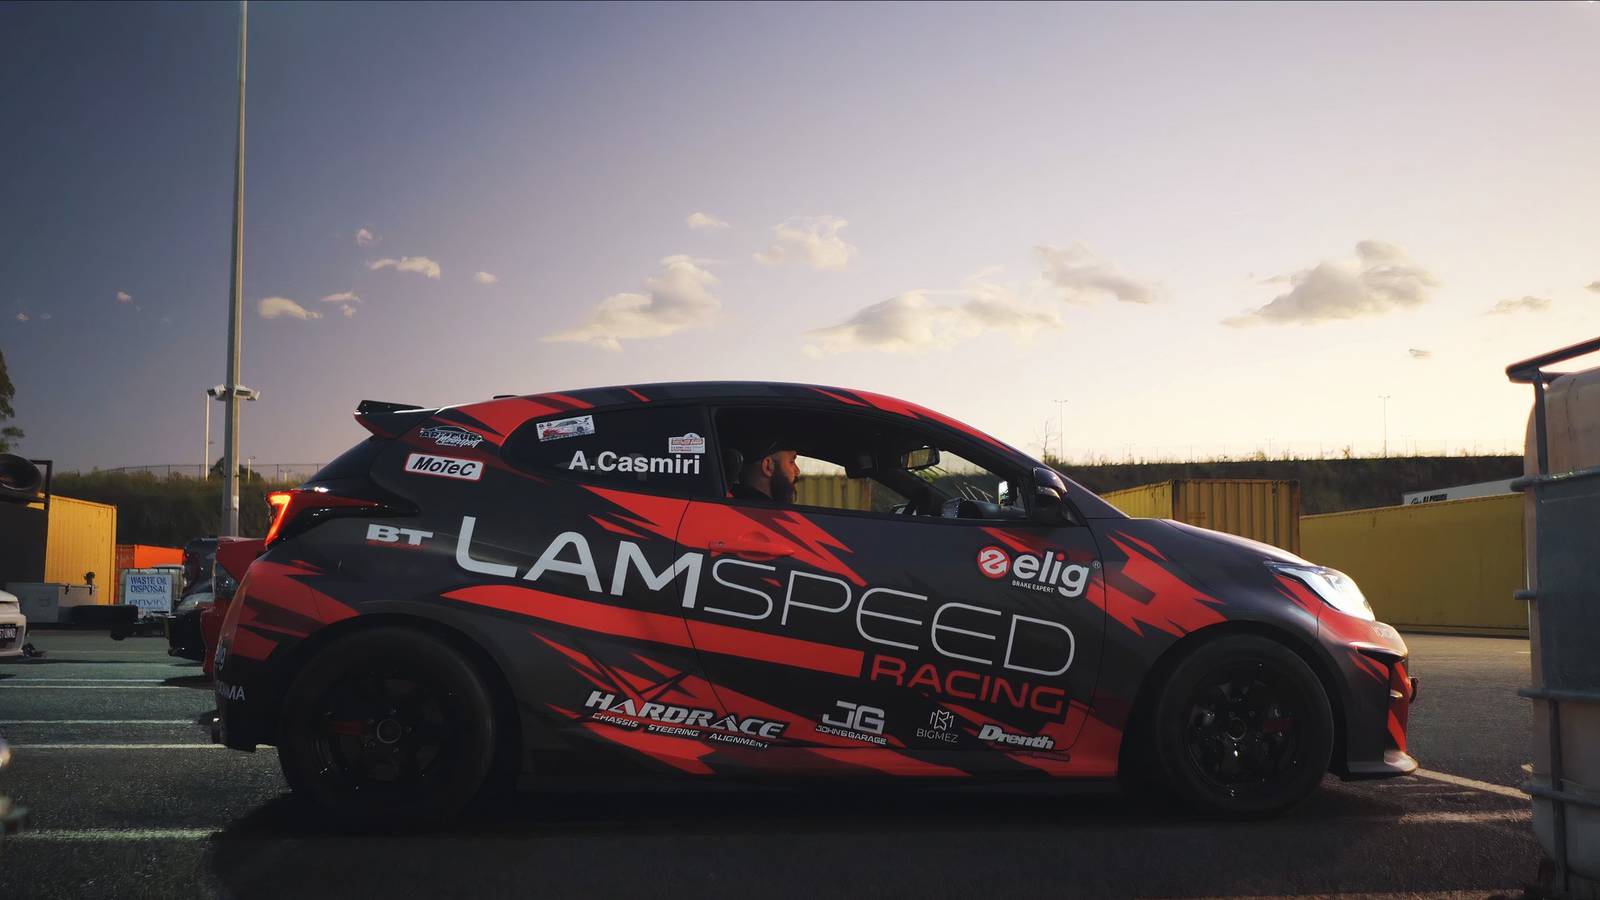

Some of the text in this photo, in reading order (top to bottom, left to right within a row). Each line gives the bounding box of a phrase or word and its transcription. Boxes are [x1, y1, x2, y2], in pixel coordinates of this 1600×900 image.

[412, 457, 476, 476] MoTeC
[568, 450, 701, 474] A.Casmiri
[366, 523, 434, 546] BT
[130, 576, 155, 585] WASTE
[1013, 551, 1090, 597] elig
[130, 585, 166, 593] DISPOSAL
[1011, 580, 1055, 593] BRAKE EXPERT
[870, 654, 1065, 715] RACING
[585, 690, 785, 739] HARDRACE
[592, 712, 640, 728] CHASSIS
[647, 724, 700, 738] STEERING
[978, 724, 1056, 750] Drenth
